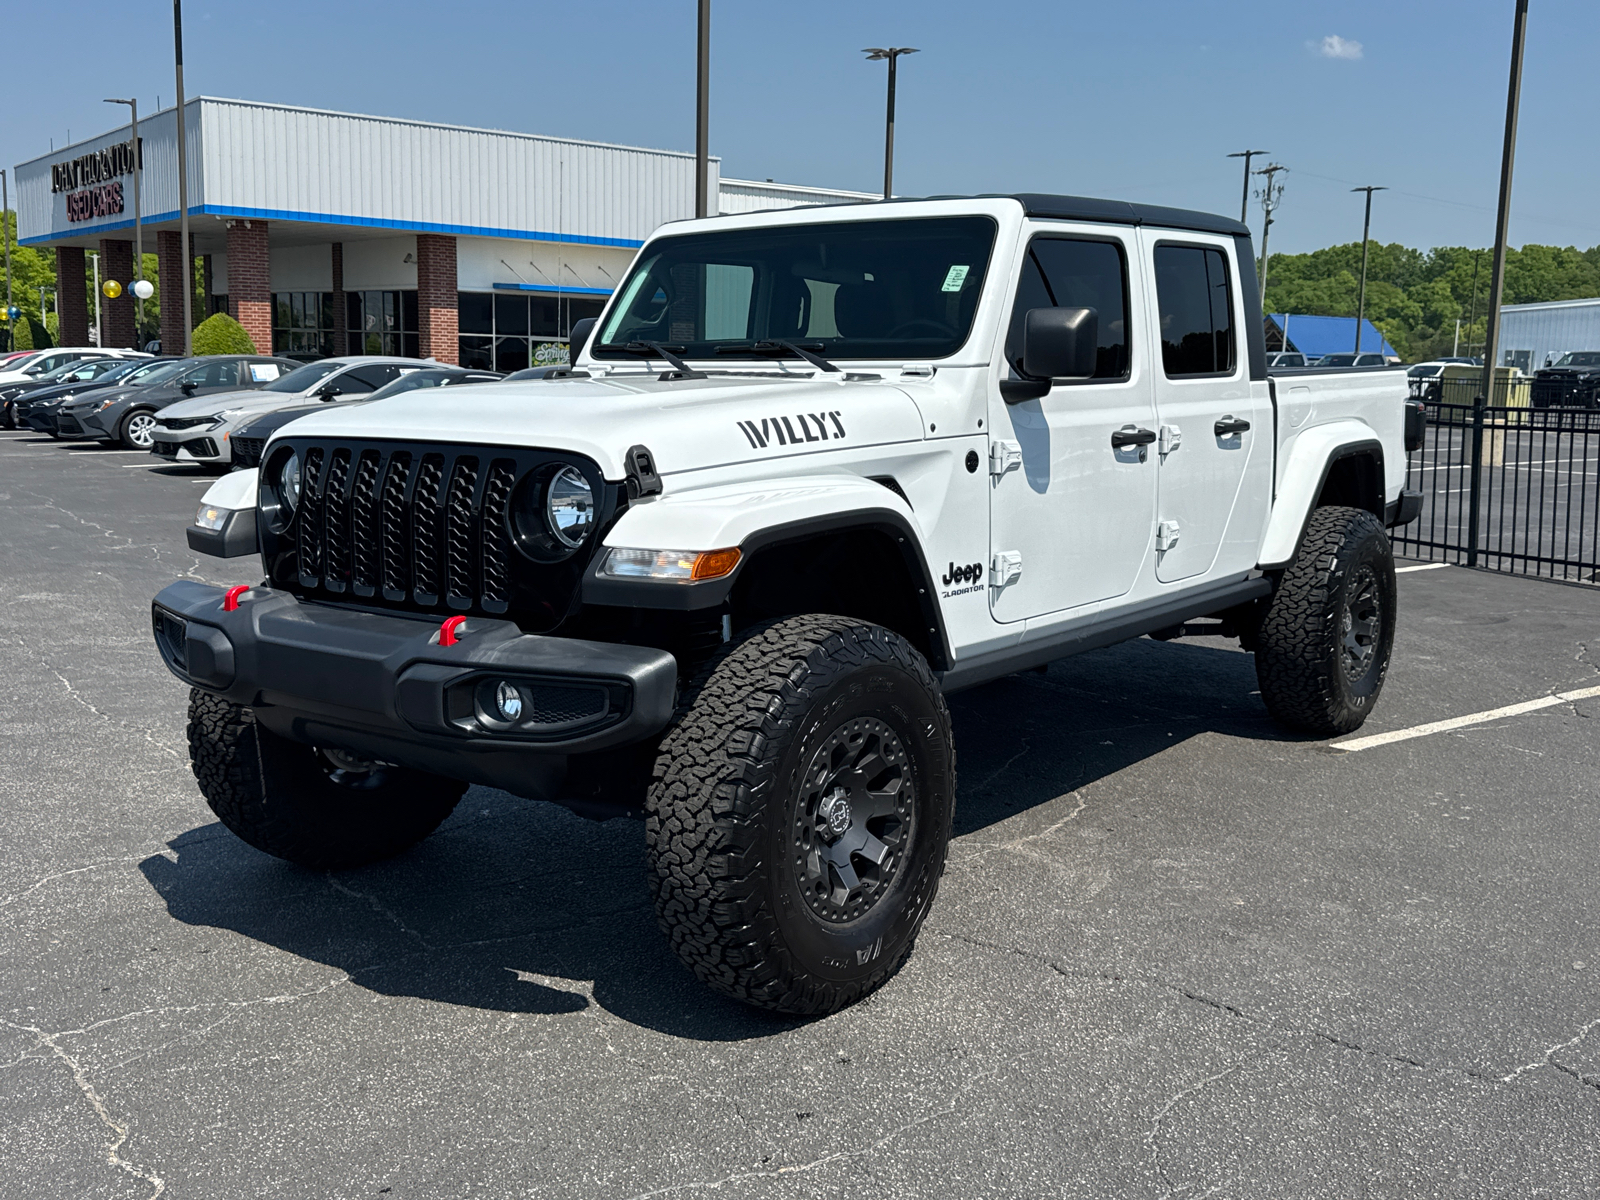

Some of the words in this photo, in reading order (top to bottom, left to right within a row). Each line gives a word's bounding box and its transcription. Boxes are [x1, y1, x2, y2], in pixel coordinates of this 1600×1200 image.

[51, 159, 78, 193] JOHN
[77, 137, 143, 186] THORNTON
[66, 190, 93, 222] USED
[92, 182, 124, 216] CARS
[535, 343, 570, 363] Spring
[736, 410, 846, 449] WILLYS
[942, 561, 983, 586] Jeep
[942, 584, 984, 598] GLADIATOR
